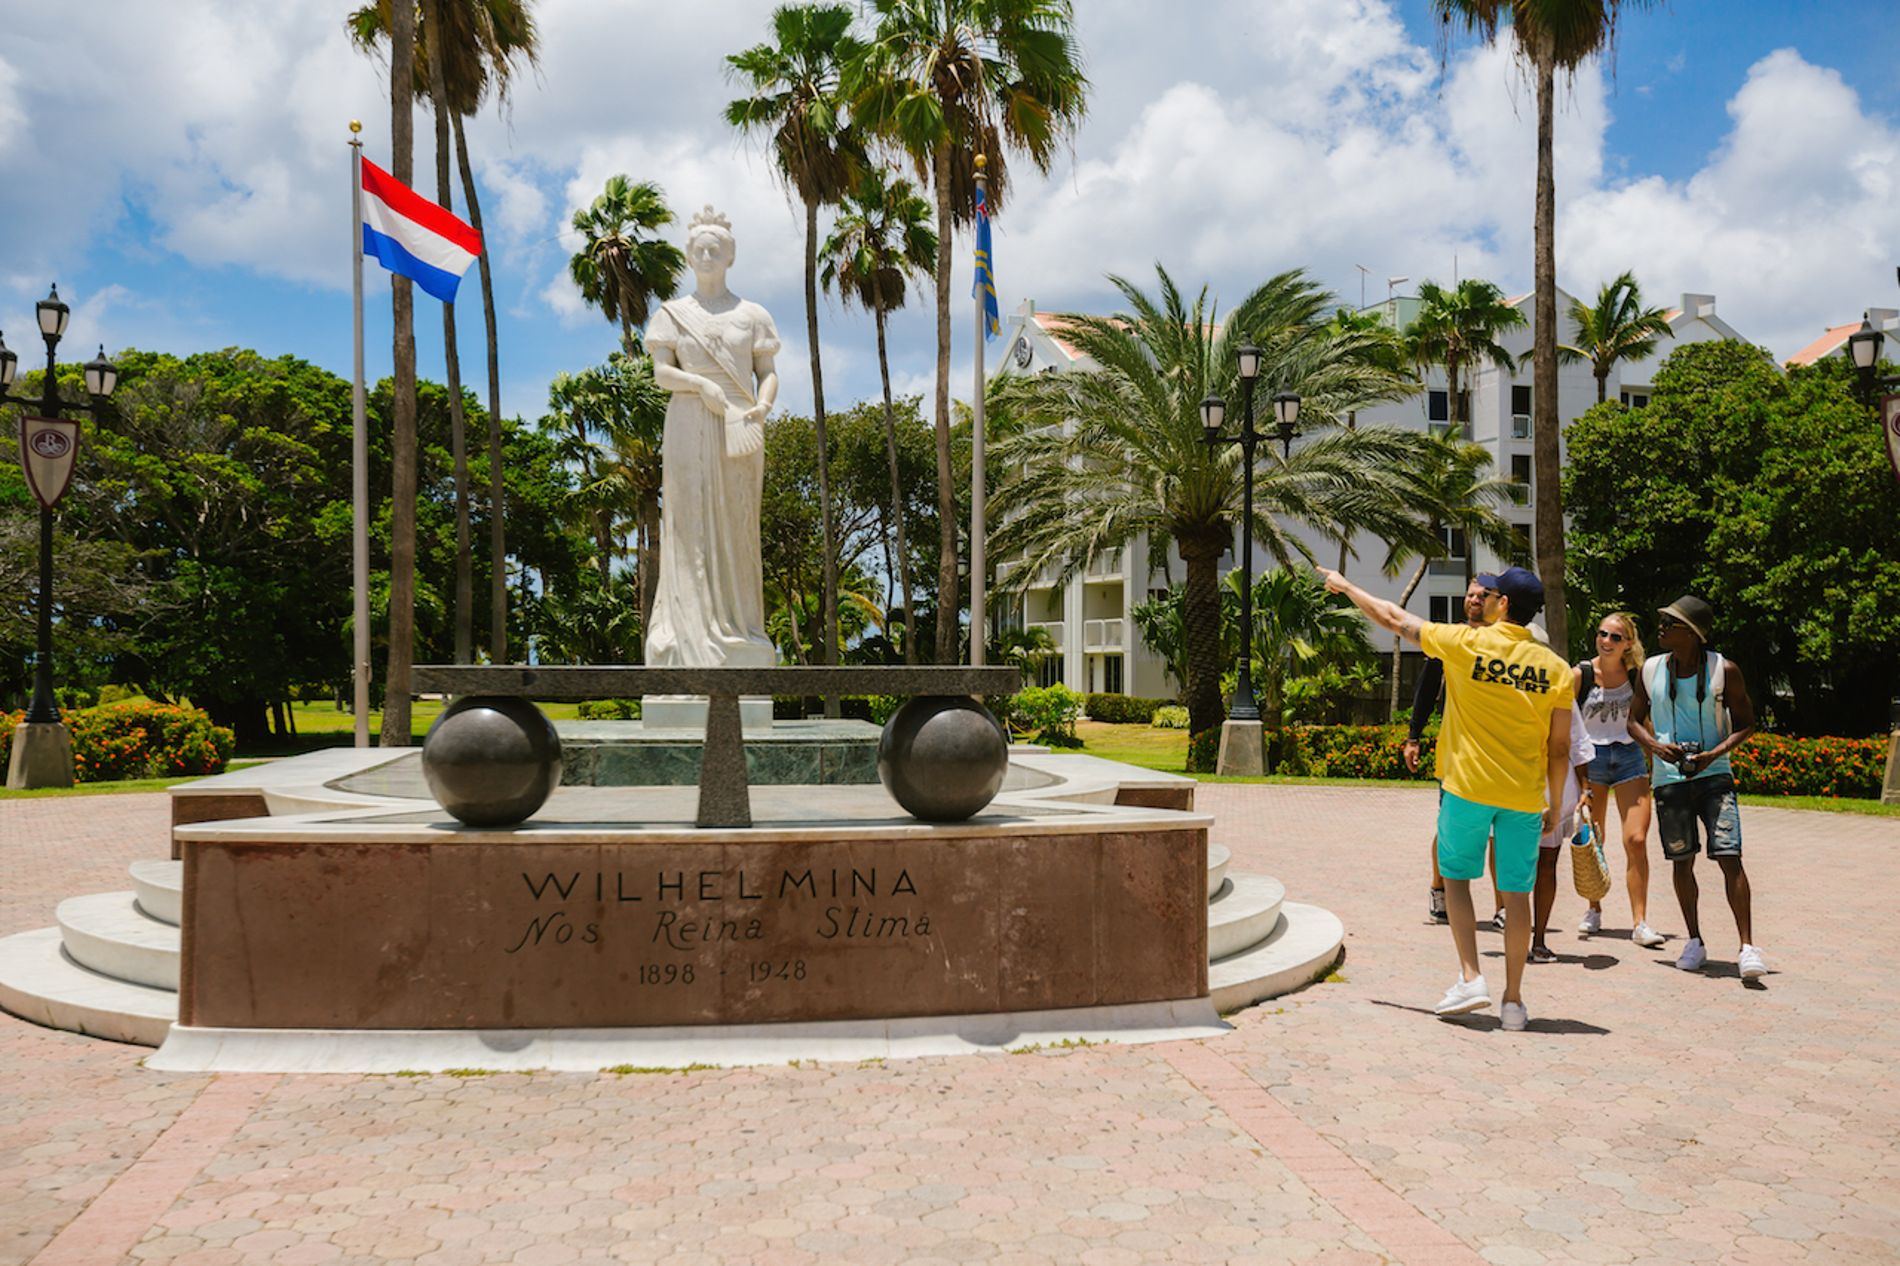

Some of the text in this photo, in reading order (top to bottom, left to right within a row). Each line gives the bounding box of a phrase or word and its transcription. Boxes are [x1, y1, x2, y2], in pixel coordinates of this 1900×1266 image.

[1474, 656, 1550, 684] LOCAL
[522, 868, 917, 901] WILHELMINA
[504, 911, 599, 954] Nos
[652, 910, 763, 951] Reina
[640, 963, 695, 985] 1898
[750, 960, 806, 982] 1948
